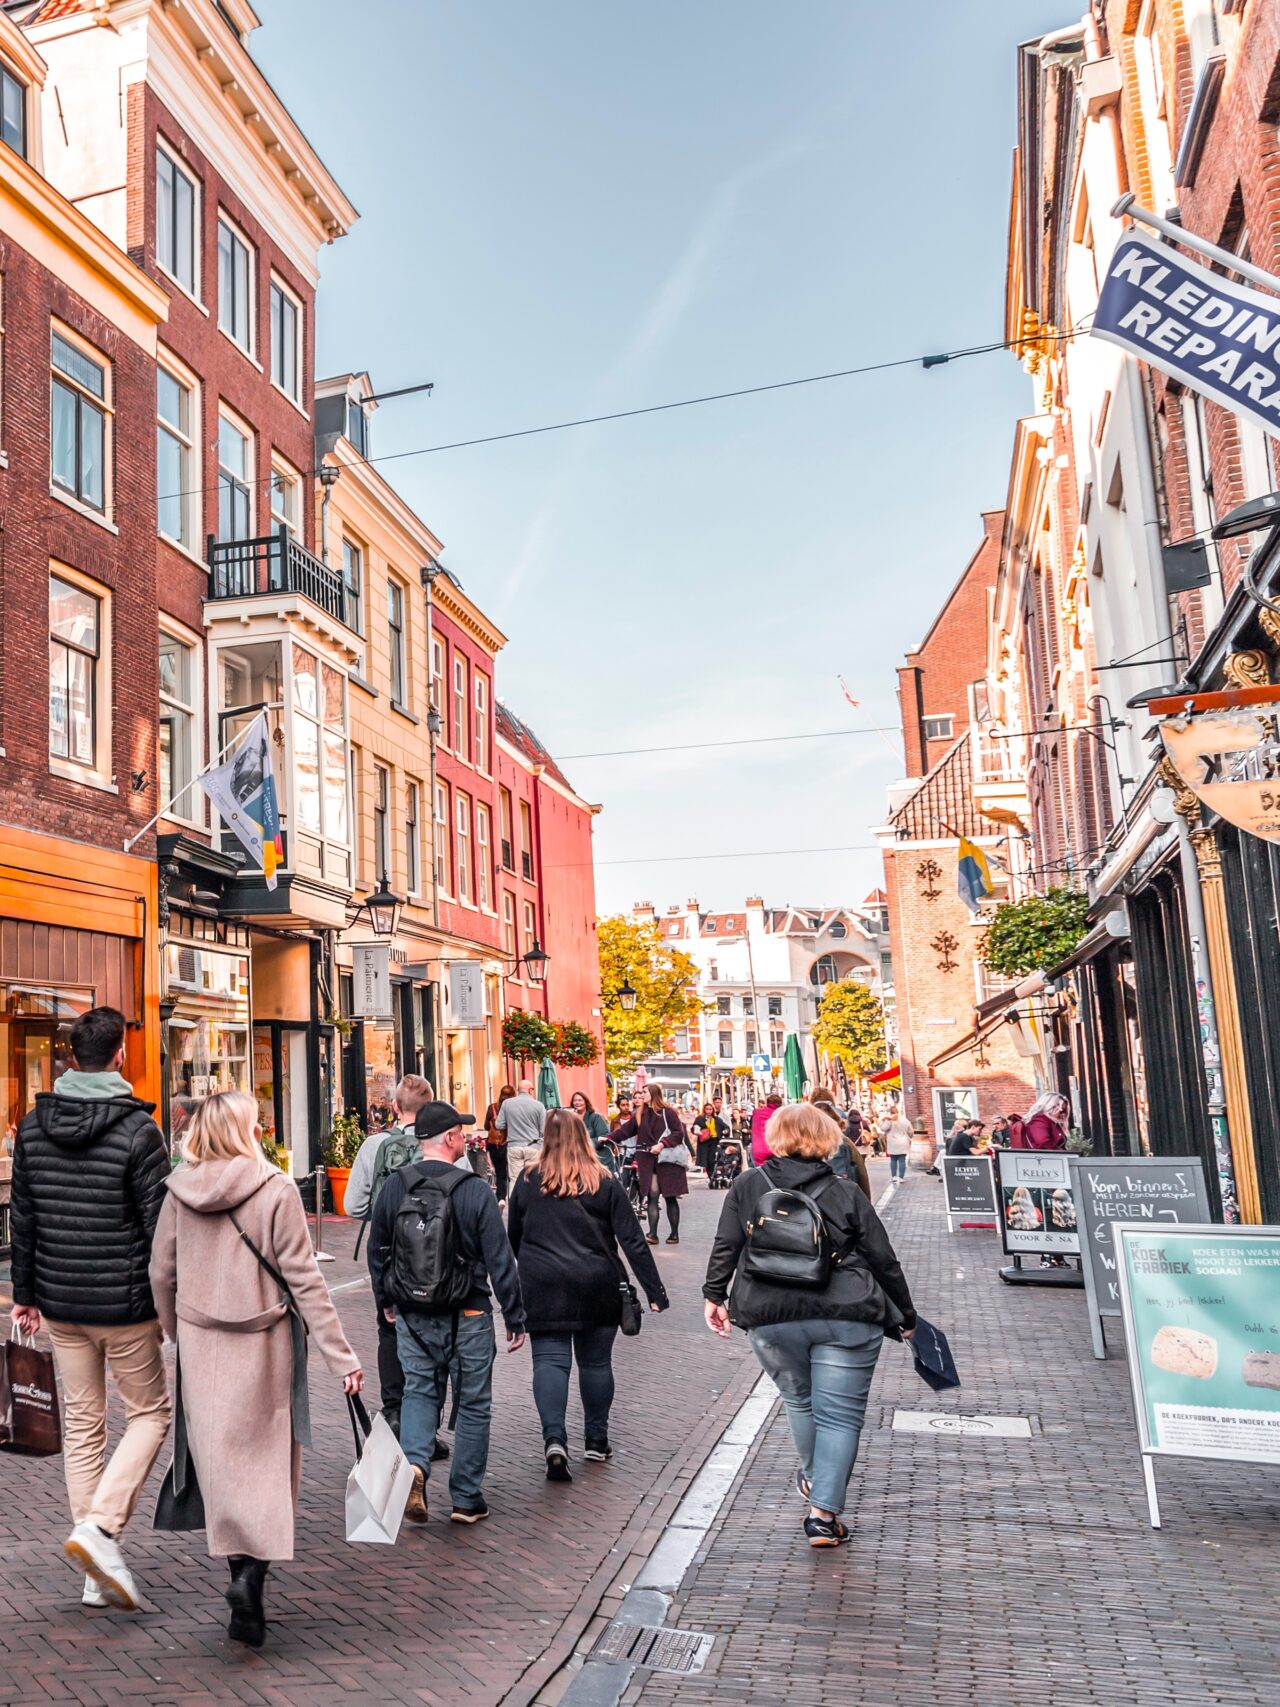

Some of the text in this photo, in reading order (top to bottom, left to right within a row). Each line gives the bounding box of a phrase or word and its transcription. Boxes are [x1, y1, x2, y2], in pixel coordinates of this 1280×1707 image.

[1111, 248, 1280, 365] KLEDIN
[1023, 1168, 1059, 1177] KELLY'S
[1088, 1173, 1121, 1193] Kom
[1093, 1200, 1154, 1218] HEREN
[1131, 1249, 1167, 1261] KOEK
[1220, 1248, 1245, 1256] ETEN
[1246, 1248, 1270, 1257] WAS
[1195, 1257, 1225, 1266] NOOIT
[1134, 1262, 1191, 1274] FABRIEK
